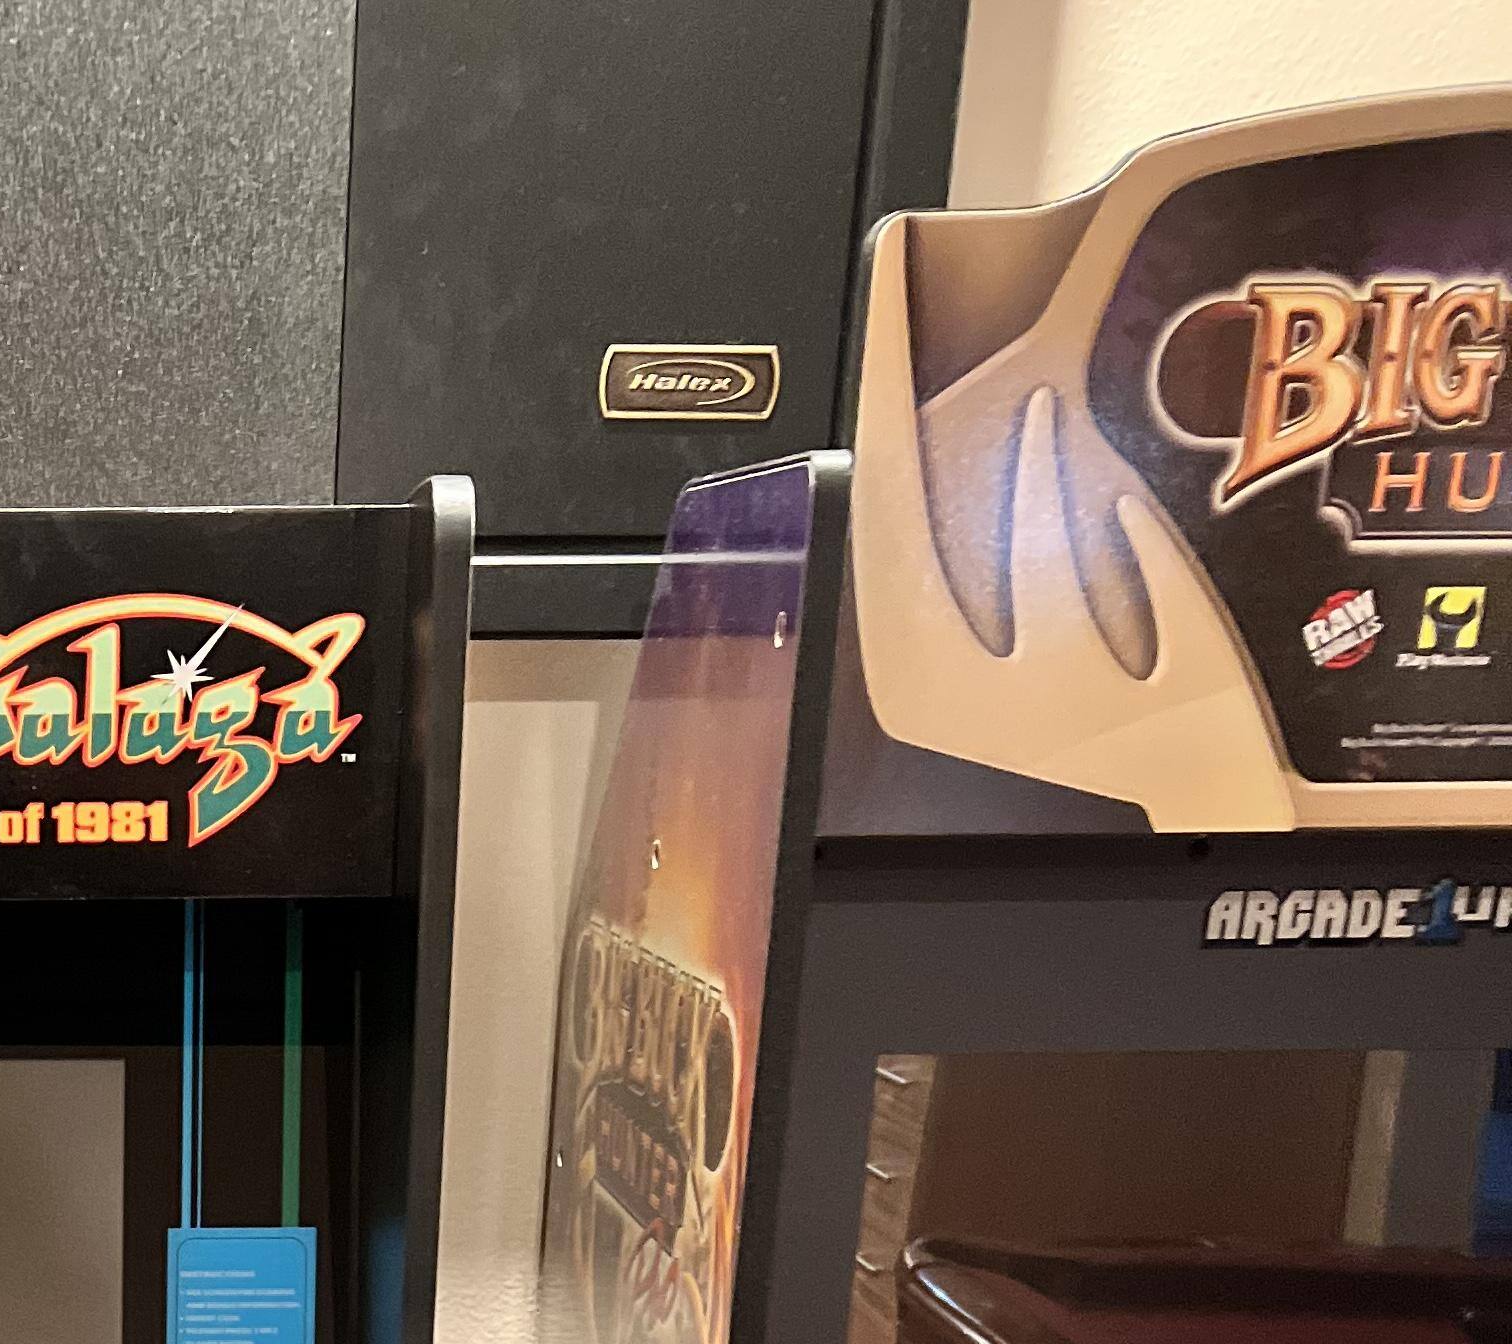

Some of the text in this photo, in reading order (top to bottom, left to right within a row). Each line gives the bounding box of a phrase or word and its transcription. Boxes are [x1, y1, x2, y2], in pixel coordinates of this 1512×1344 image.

[628, 373, 732, 392] Halex
[1221, 280, 1502, 502] BIG
[51, 800, 169, 843] 1981
